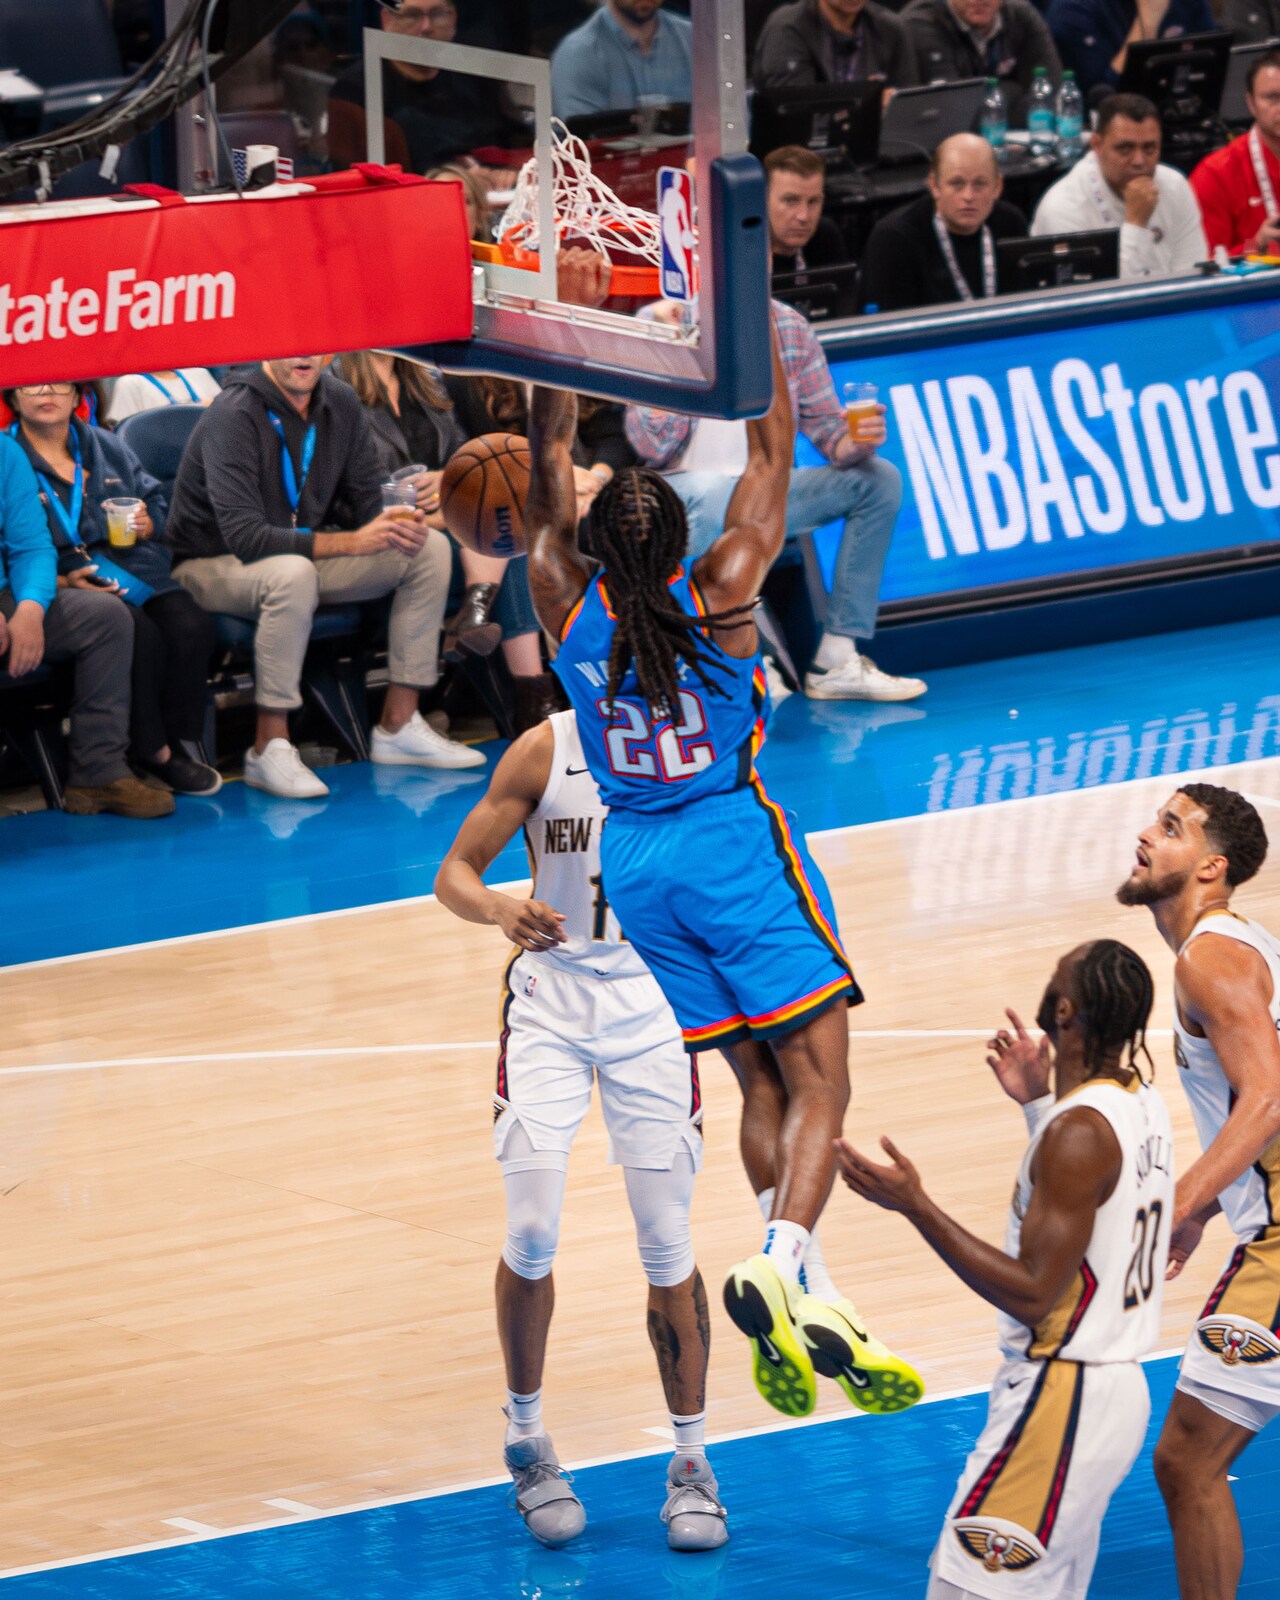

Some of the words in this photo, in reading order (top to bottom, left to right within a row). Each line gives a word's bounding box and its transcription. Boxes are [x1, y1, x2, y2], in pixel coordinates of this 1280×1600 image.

[596, 689, 717, 783] 22
[545, 816, 594, 854] NEW
[589, 873, 630, 942] 1
[1123, 1199, 1163, 1313] 20
